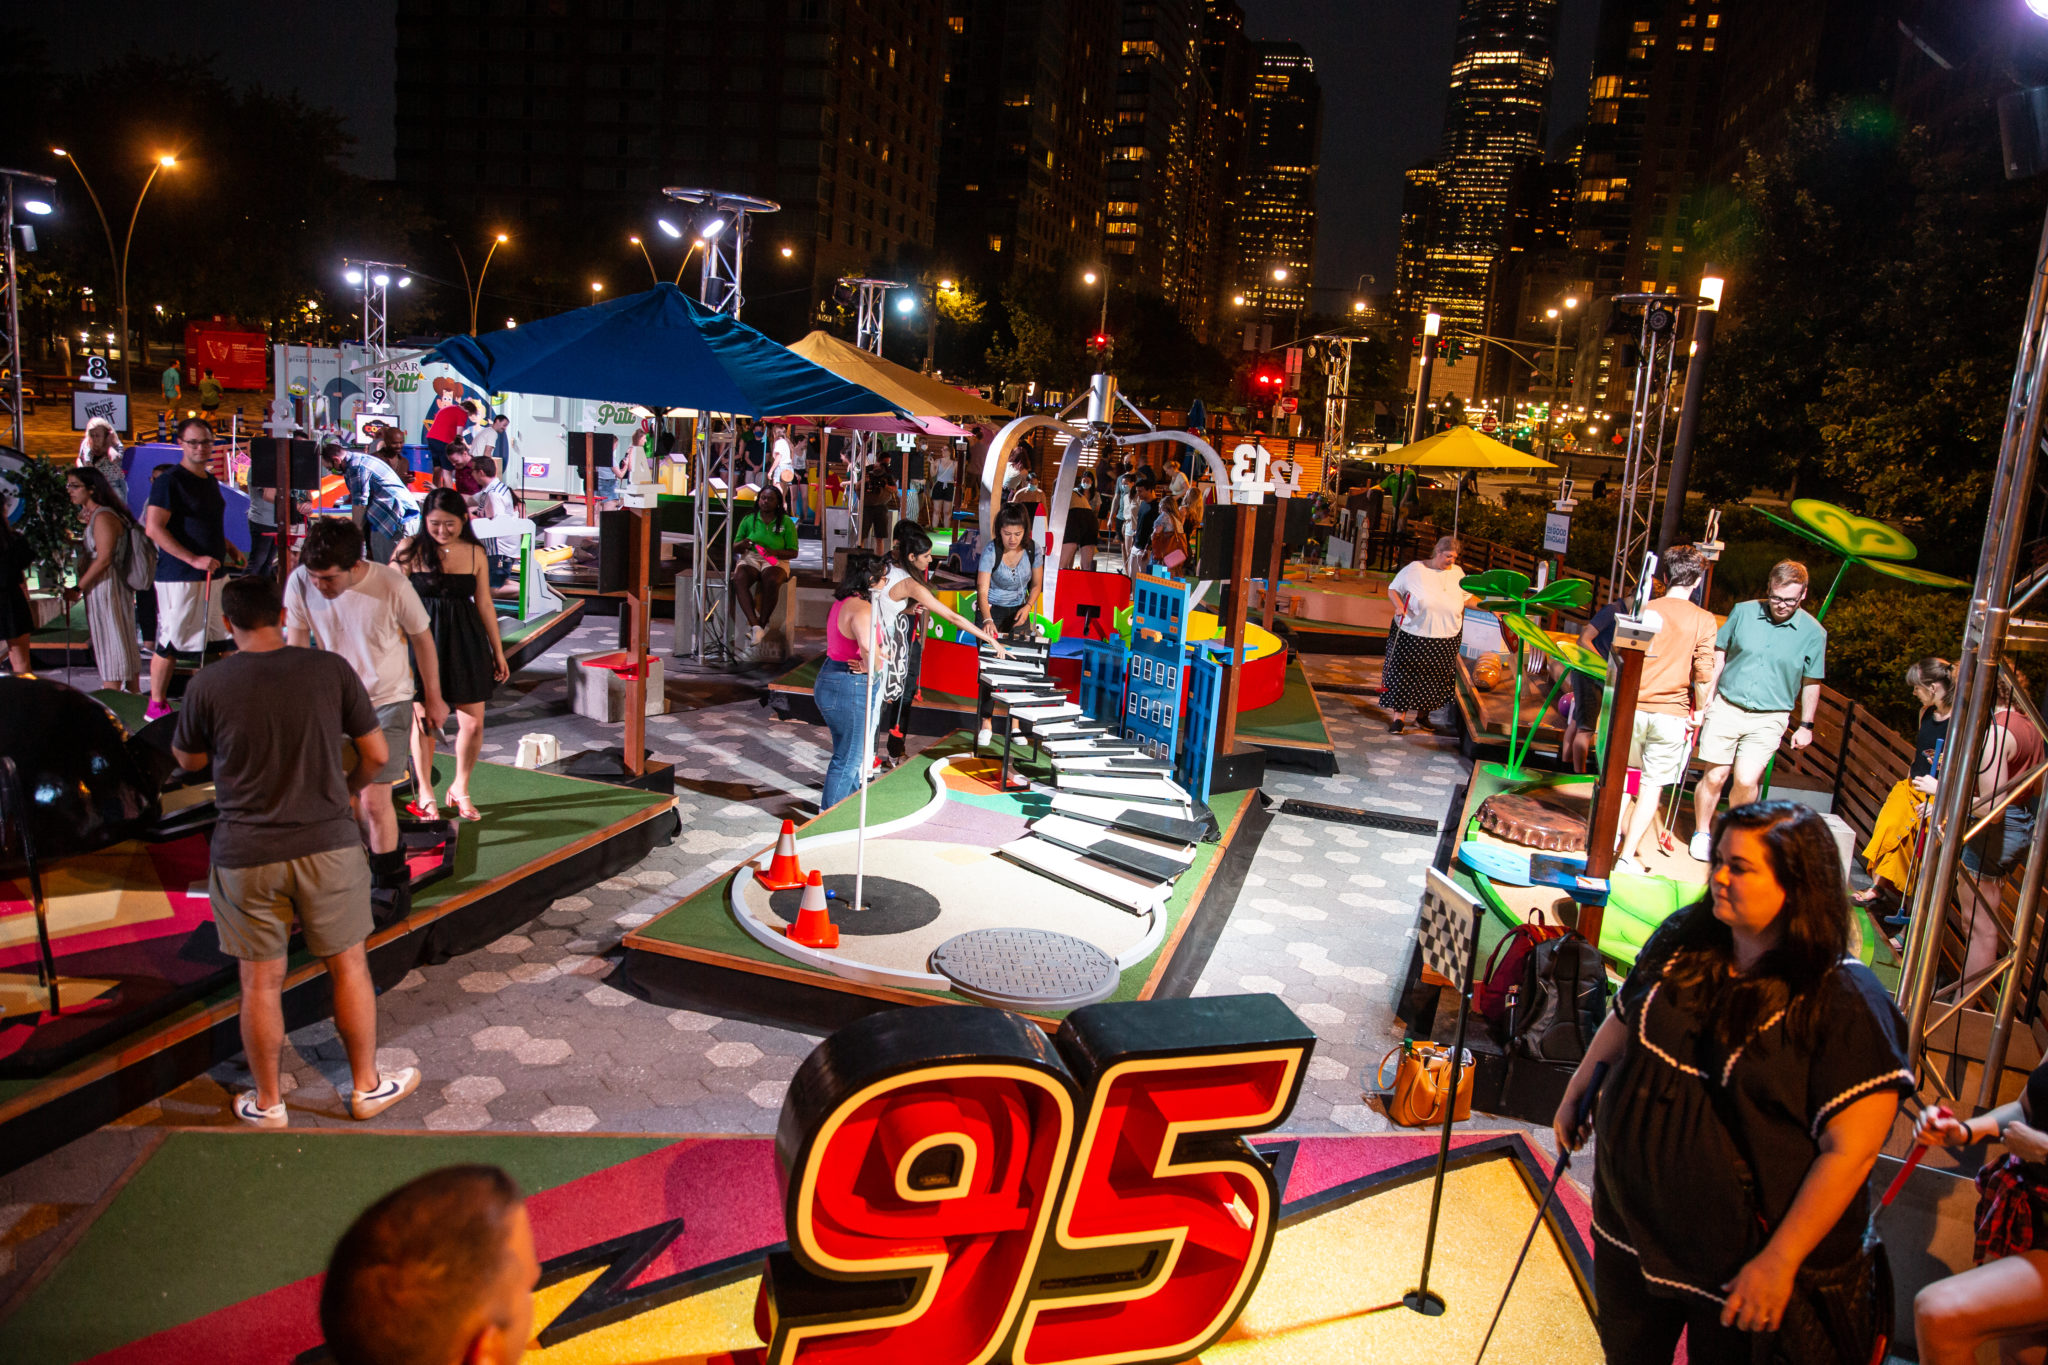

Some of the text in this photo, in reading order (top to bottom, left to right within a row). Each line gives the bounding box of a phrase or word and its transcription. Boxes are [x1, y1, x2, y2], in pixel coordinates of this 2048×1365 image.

[88, 356, 108, 379] 8
[389, 361, 419, 371] IXAR
[372, 388, 386, 405] 9
[85, 402, 117, 420] INSIDE
[772, 1022, 1308, 1365] 95
